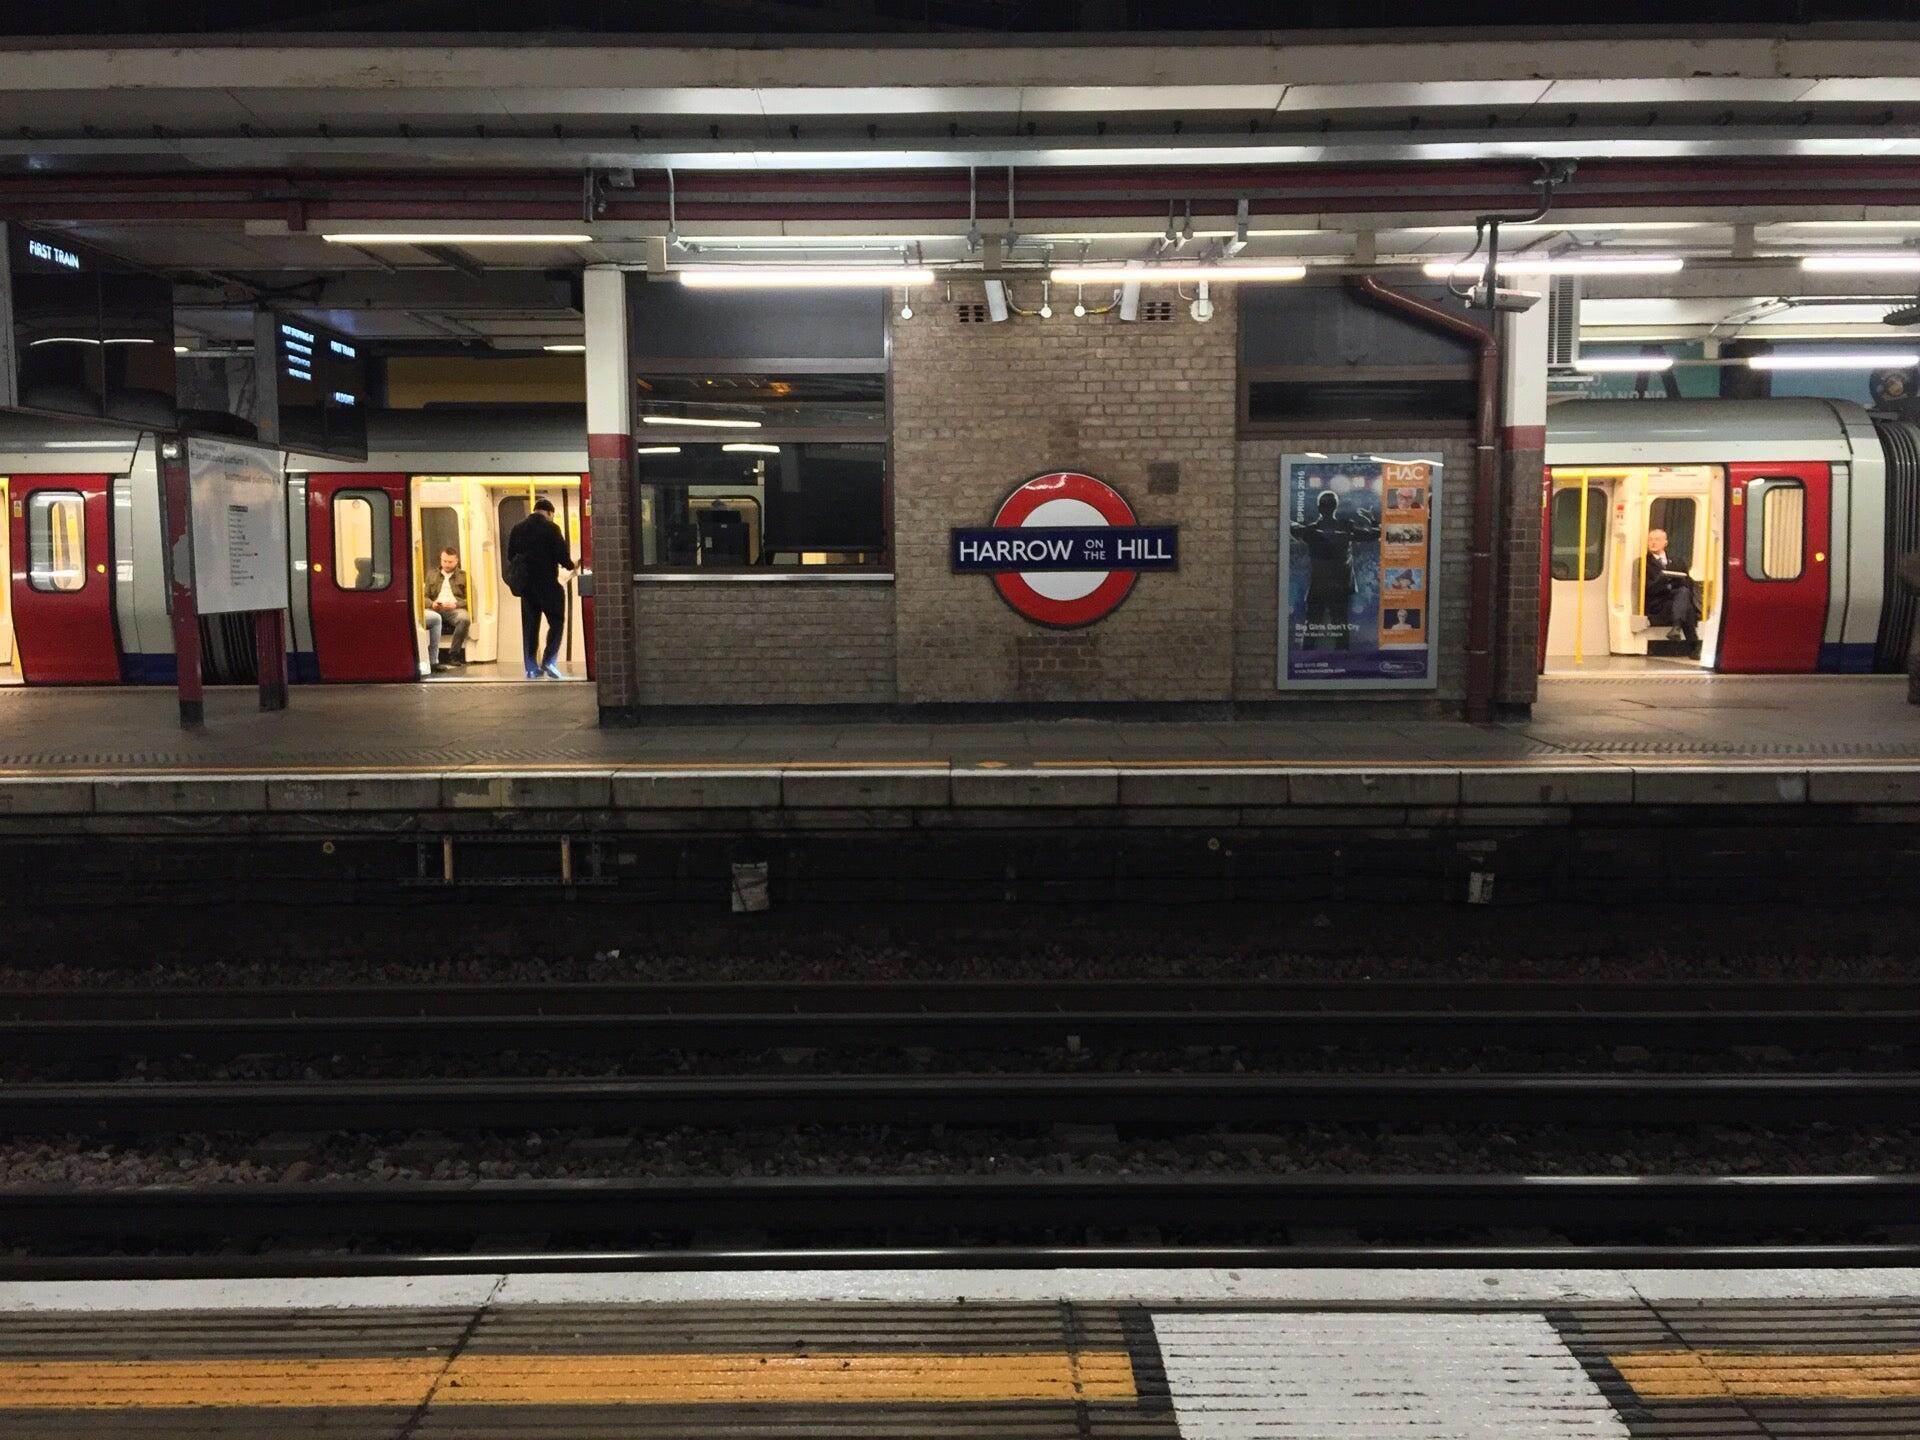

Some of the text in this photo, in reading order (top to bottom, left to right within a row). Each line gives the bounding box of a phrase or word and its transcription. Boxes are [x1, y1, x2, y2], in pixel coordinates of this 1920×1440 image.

[29, 239, 80, 269] FIRST TRAIN
[1386, 466, 1424, 481] HAC
[1296, 490, 1305, 523] SPRING
[959, 538, 1172, 561] HARROW ON THE HILL
[1295, 624, 1307, 632] Big
